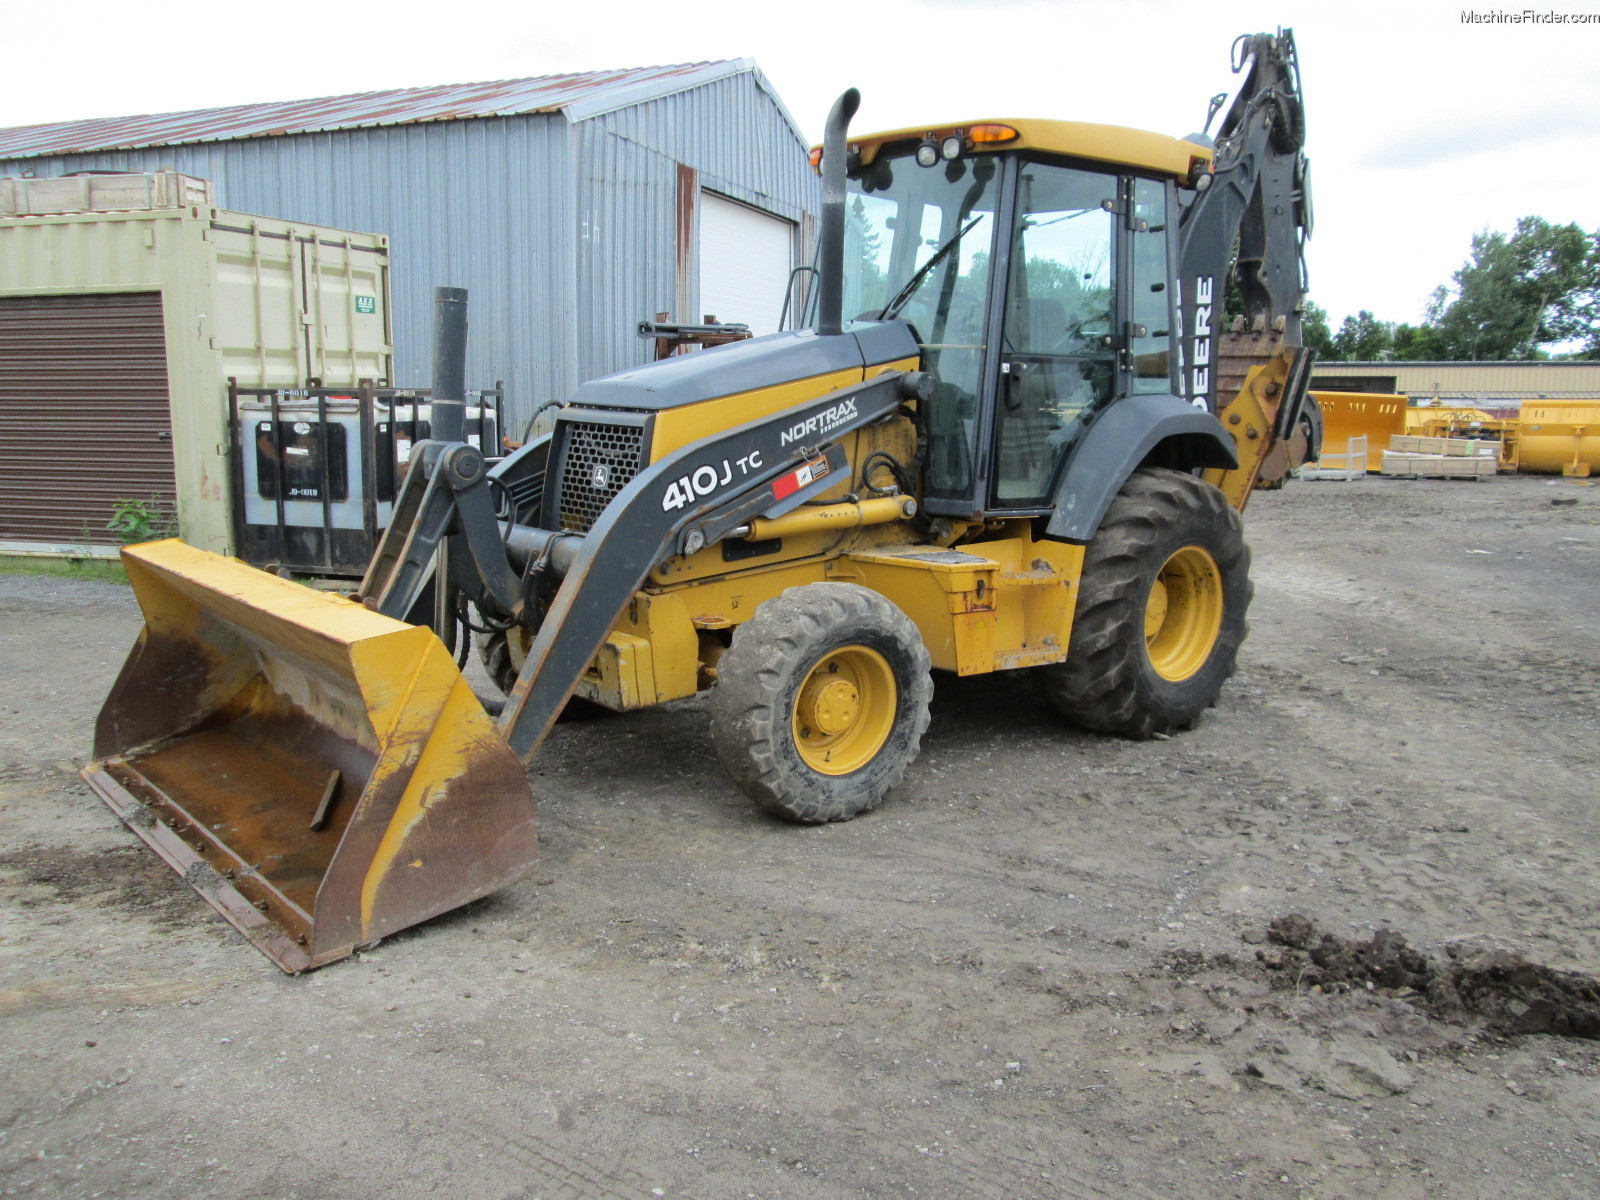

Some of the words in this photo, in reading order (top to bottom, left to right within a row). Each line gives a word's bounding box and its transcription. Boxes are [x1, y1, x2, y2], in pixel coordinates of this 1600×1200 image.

[781, 396, 857, 447] NORTRAX
[289, 488, 318, 496] JD-0018
[662, 459, 734, 512] 410J
[736, 450, 763, 475] TC
